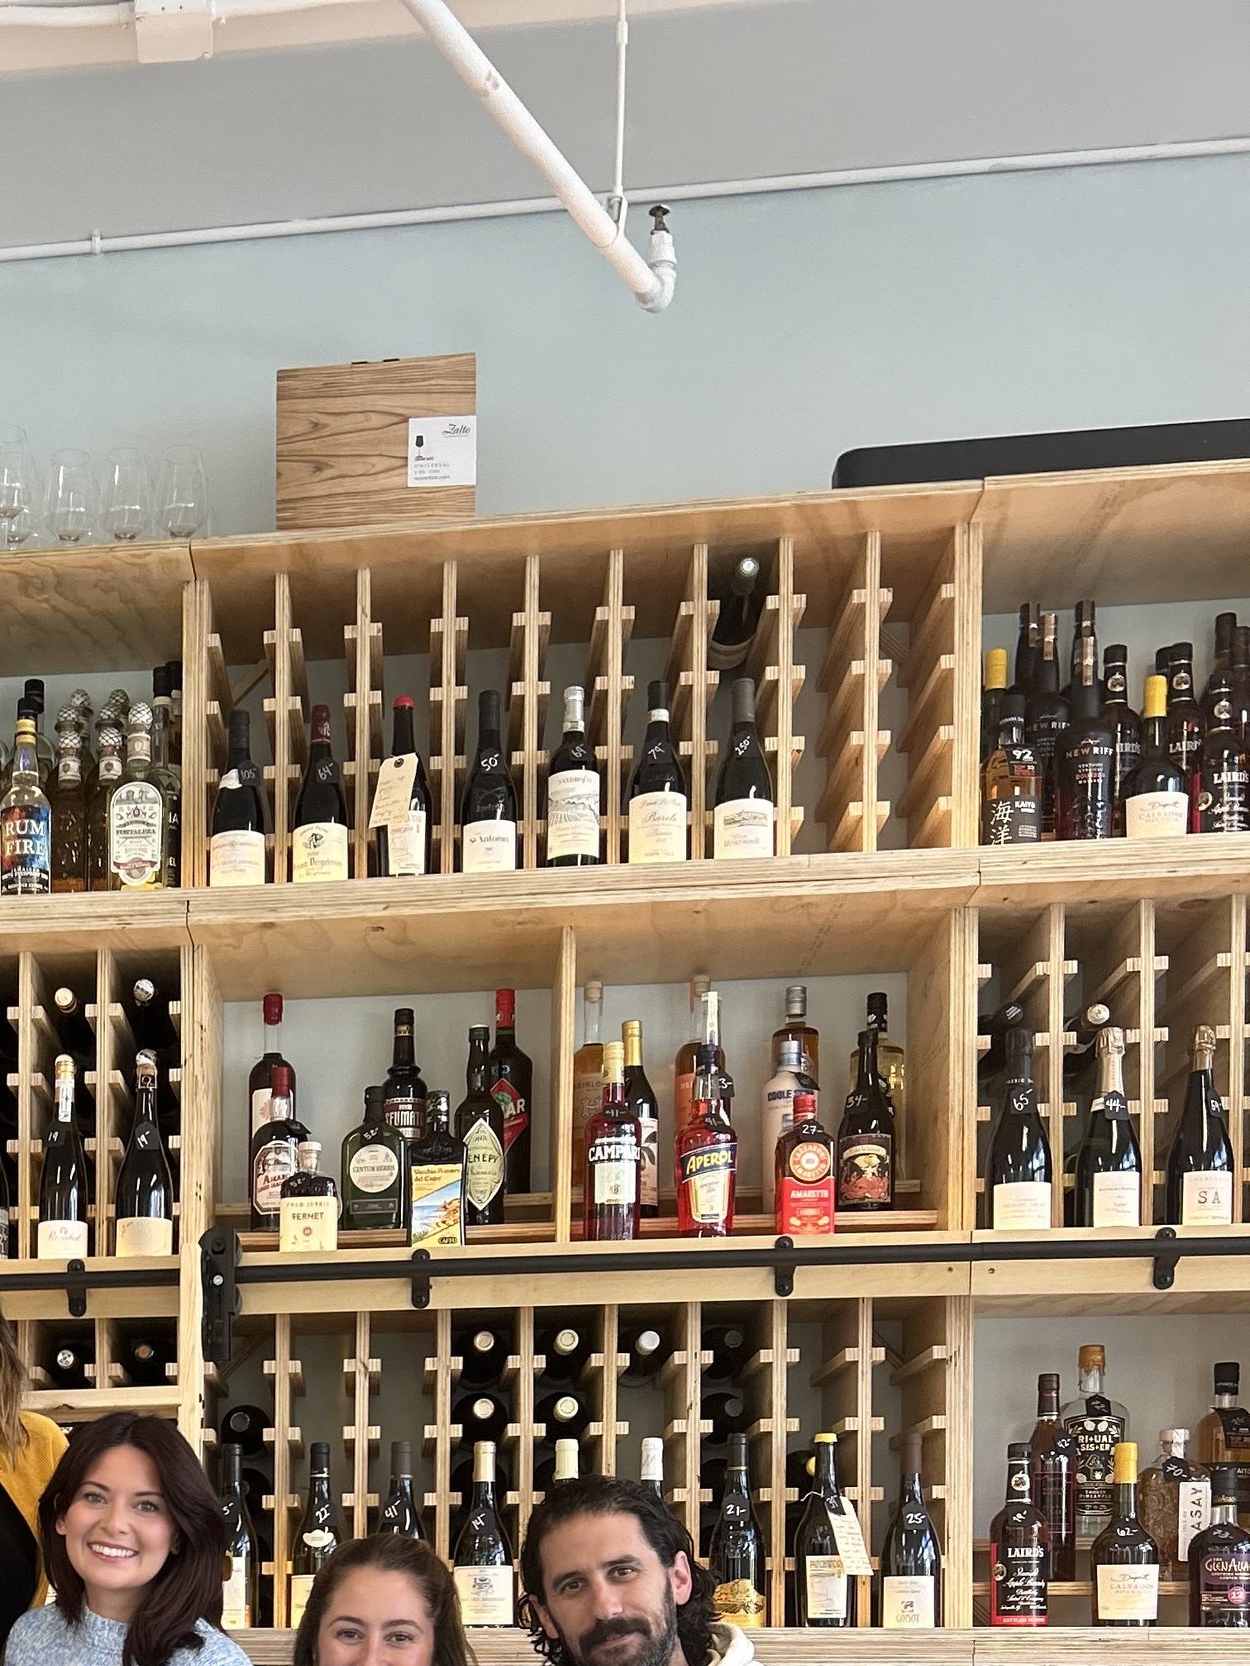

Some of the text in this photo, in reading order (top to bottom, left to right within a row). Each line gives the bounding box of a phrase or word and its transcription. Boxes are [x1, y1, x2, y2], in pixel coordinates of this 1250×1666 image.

[1012, 749, 1034, 762] 92
[1066, 746, 1114, 759] NEW RIFF
[5, 819, 45, 836] RUM
[5, 839, 46, 857] FIRE
[768, 1089, 792, 1102] COOLE
[1013, 1089, 1033, 1112] 65-
[1105, 1098, 1126, 1113] 44-
[385, 1110, 425, 1126] SFUMAT
[802, 1124, 823, 1135] 27-
[588, 1143, 641, 1162] CAMPARI
[686, 1154, 733, 1175] APEROL
[291, 1212, 324, 1221] FERNET
[726, 1504, 747, 1516] 21-
[906, 1512, 926, 1524] 25-
[1007, 1546, 1044, 1558] LAIRD'S
